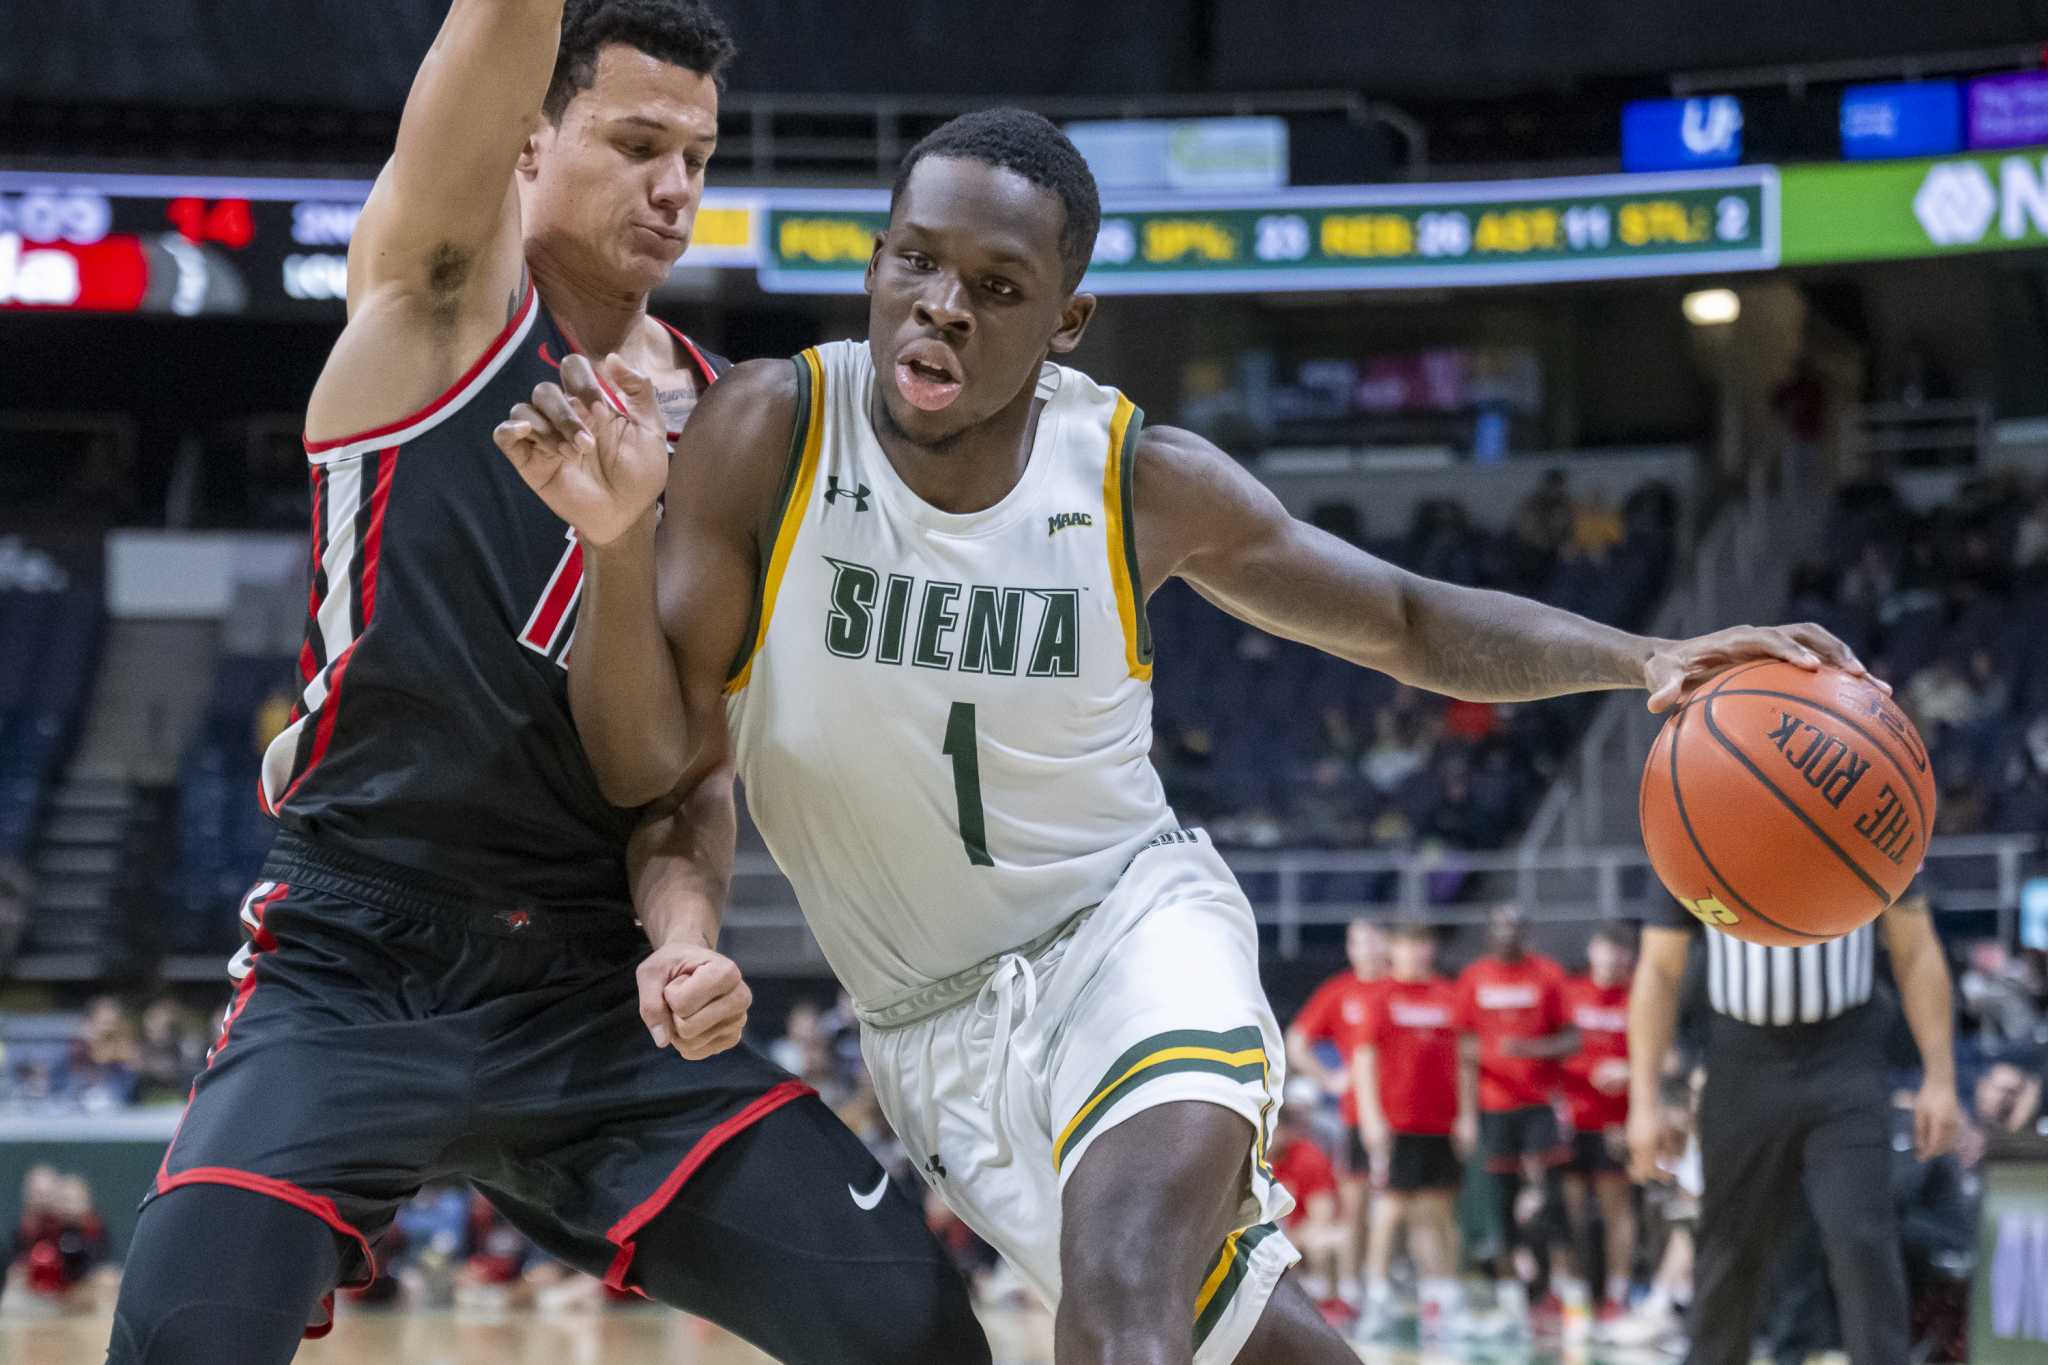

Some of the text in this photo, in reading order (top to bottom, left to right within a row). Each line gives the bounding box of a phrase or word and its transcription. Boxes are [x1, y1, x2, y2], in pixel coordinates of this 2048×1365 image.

[1716, 195, 1749, 242] 2
[1048, 511, 1093, 537] MAAC
[821, 554, 1080, 679] SIENA
[942, 701, 995, 868] 1
[1768, 712, 1870, 810] ROCK
[1854, 784, 1915, 865] THE
